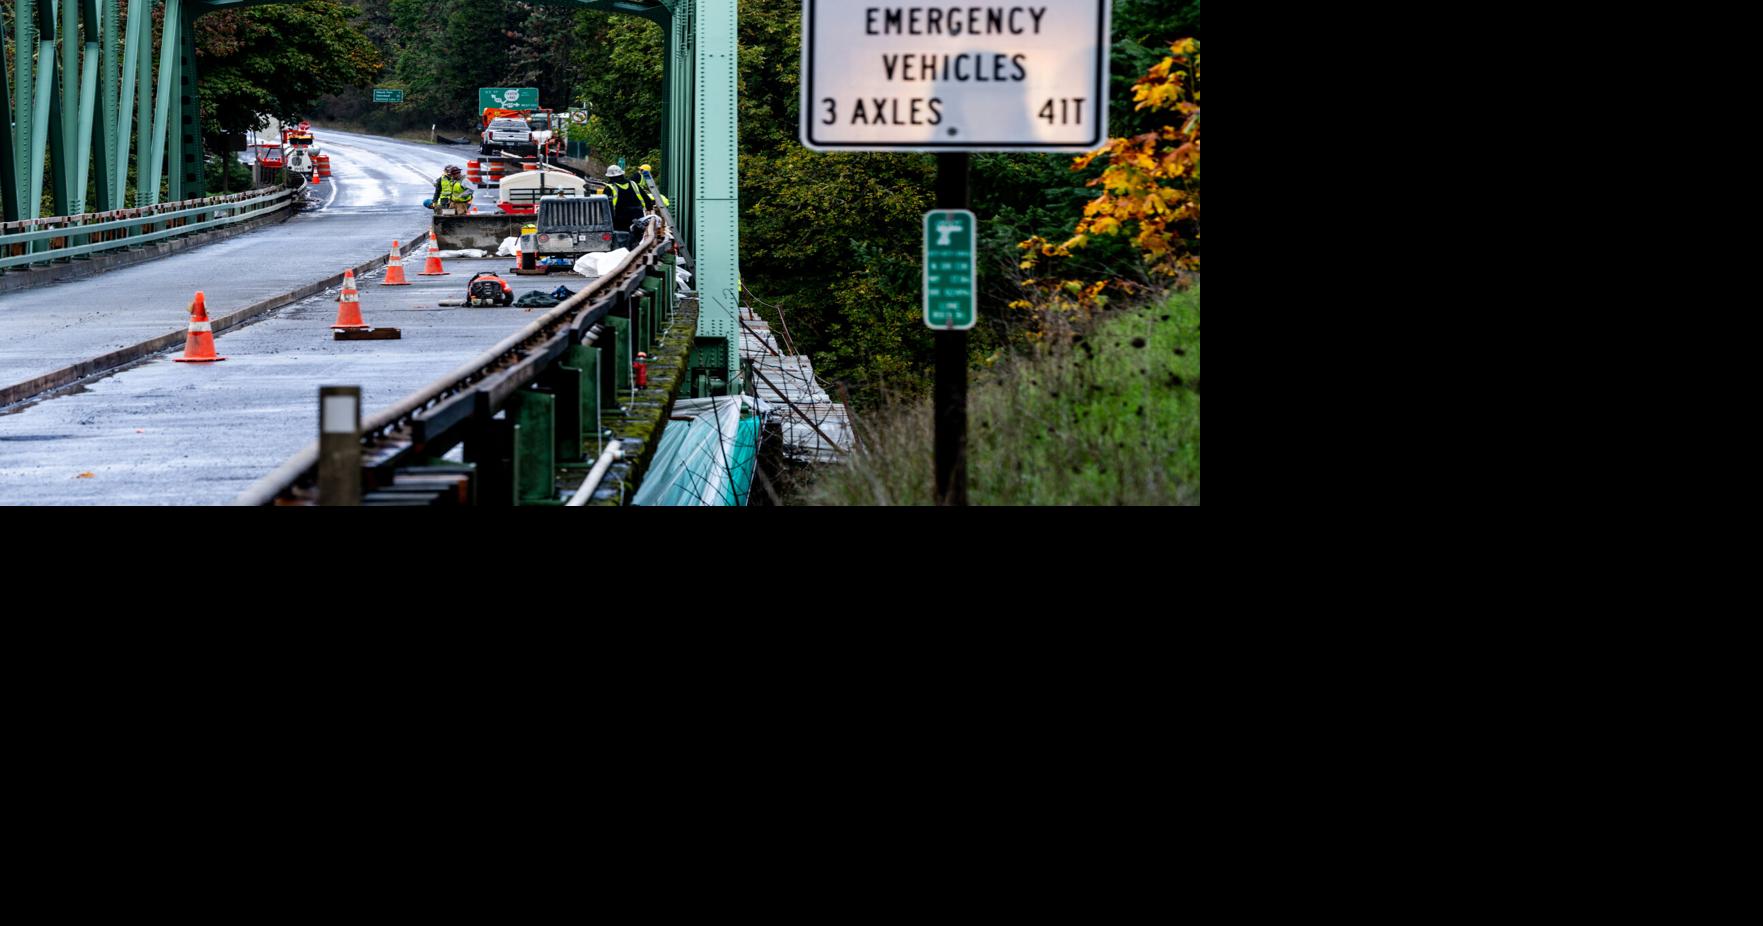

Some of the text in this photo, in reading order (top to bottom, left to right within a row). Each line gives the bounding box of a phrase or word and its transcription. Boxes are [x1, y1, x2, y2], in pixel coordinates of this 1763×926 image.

[865, 6, 1047, 36] EMERGENCY
[882, 53, 1027, 82] VEHICLES
[821, 97, 943, 125] 3 AXLES
[1038, 98, 1086, 125] 41T
